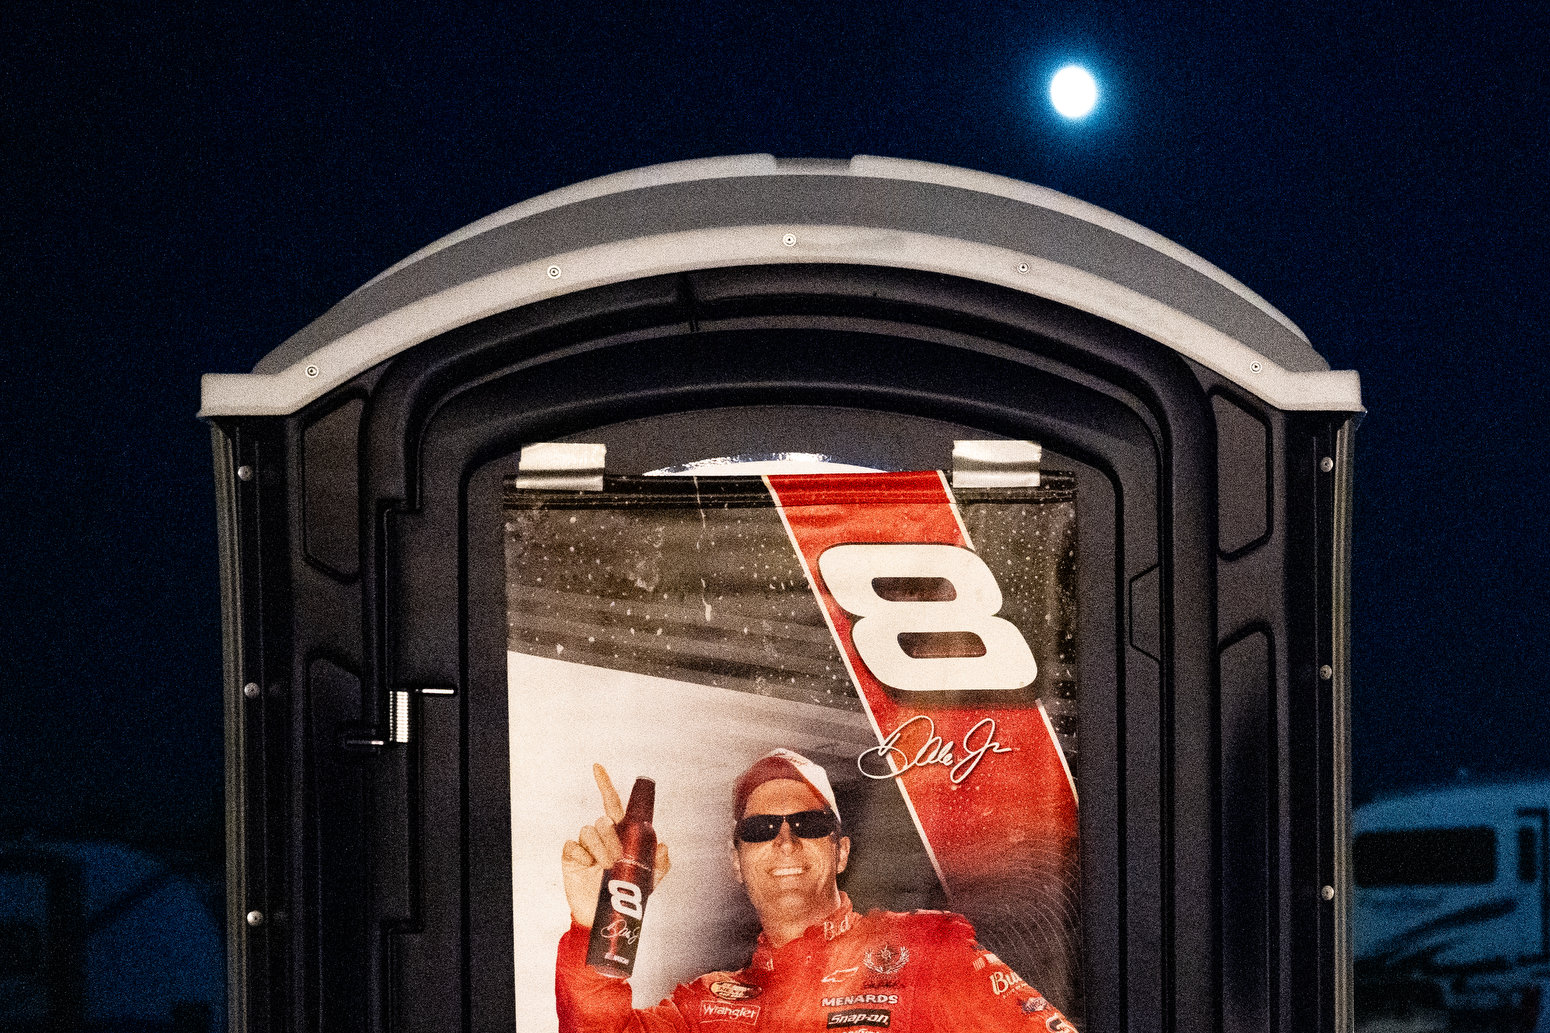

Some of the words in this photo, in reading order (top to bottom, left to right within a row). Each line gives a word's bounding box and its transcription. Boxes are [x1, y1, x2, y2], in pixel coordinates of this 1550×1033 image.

[817, 544, 1038, 691] 8
[608, 879, 643, 921] 8
[821, 994, 898, 1007] MENARDS
[703, 1003, 756, 1020] Wrangler
[828, 1013, 889, 1025] Snap-on
